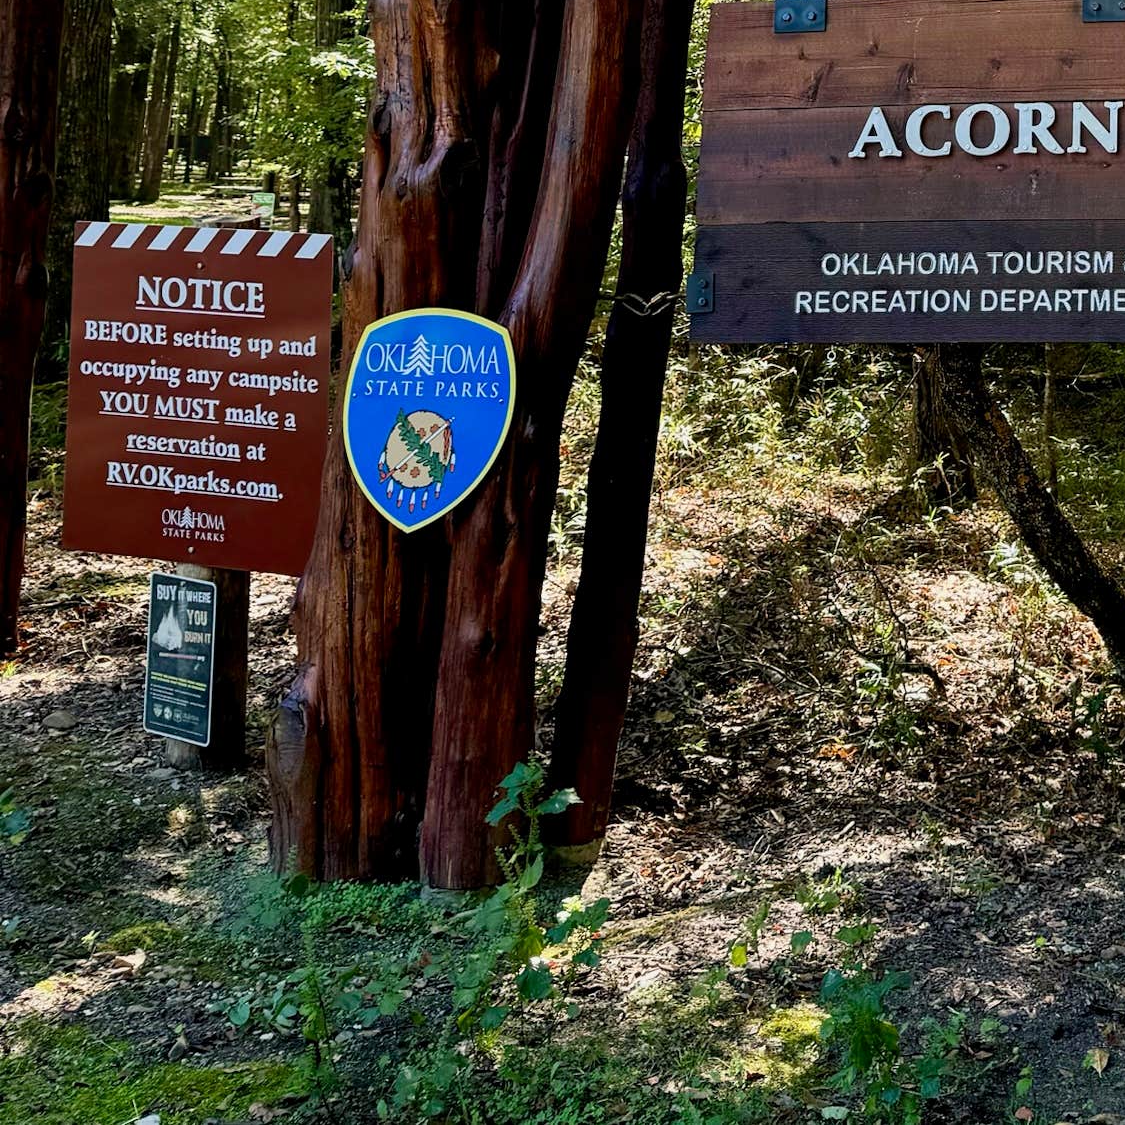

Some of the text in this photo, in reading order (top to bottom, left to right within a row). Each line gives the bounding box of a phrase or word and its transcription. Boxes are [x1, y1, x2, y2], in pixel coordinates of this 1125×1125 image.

[848, 101, 1123, 158] ACORN
[821, 252, 978, 276] OKLAHOMA
[987, 251, 1113, 275] TOURISM
[136, 275, 265, 314] NOTICE
[795, 289, 971, 314] RECREATION
[85, 320, 317, 359] BEFORE setting up and
[80, 359, 319, 396] occupying any campsite
[365, 380, 499, 398] STATE PARKS
[100, 391, 297, 429] YOU MUST make a
[126, 432, 266, 461] reservation at
[162, 527, 225, 542] STATE PARKS
[156, 584, 177, 601] BUY
[186, 590, 212, 603] WHERE
[187, 609, 208, 626] YOU
